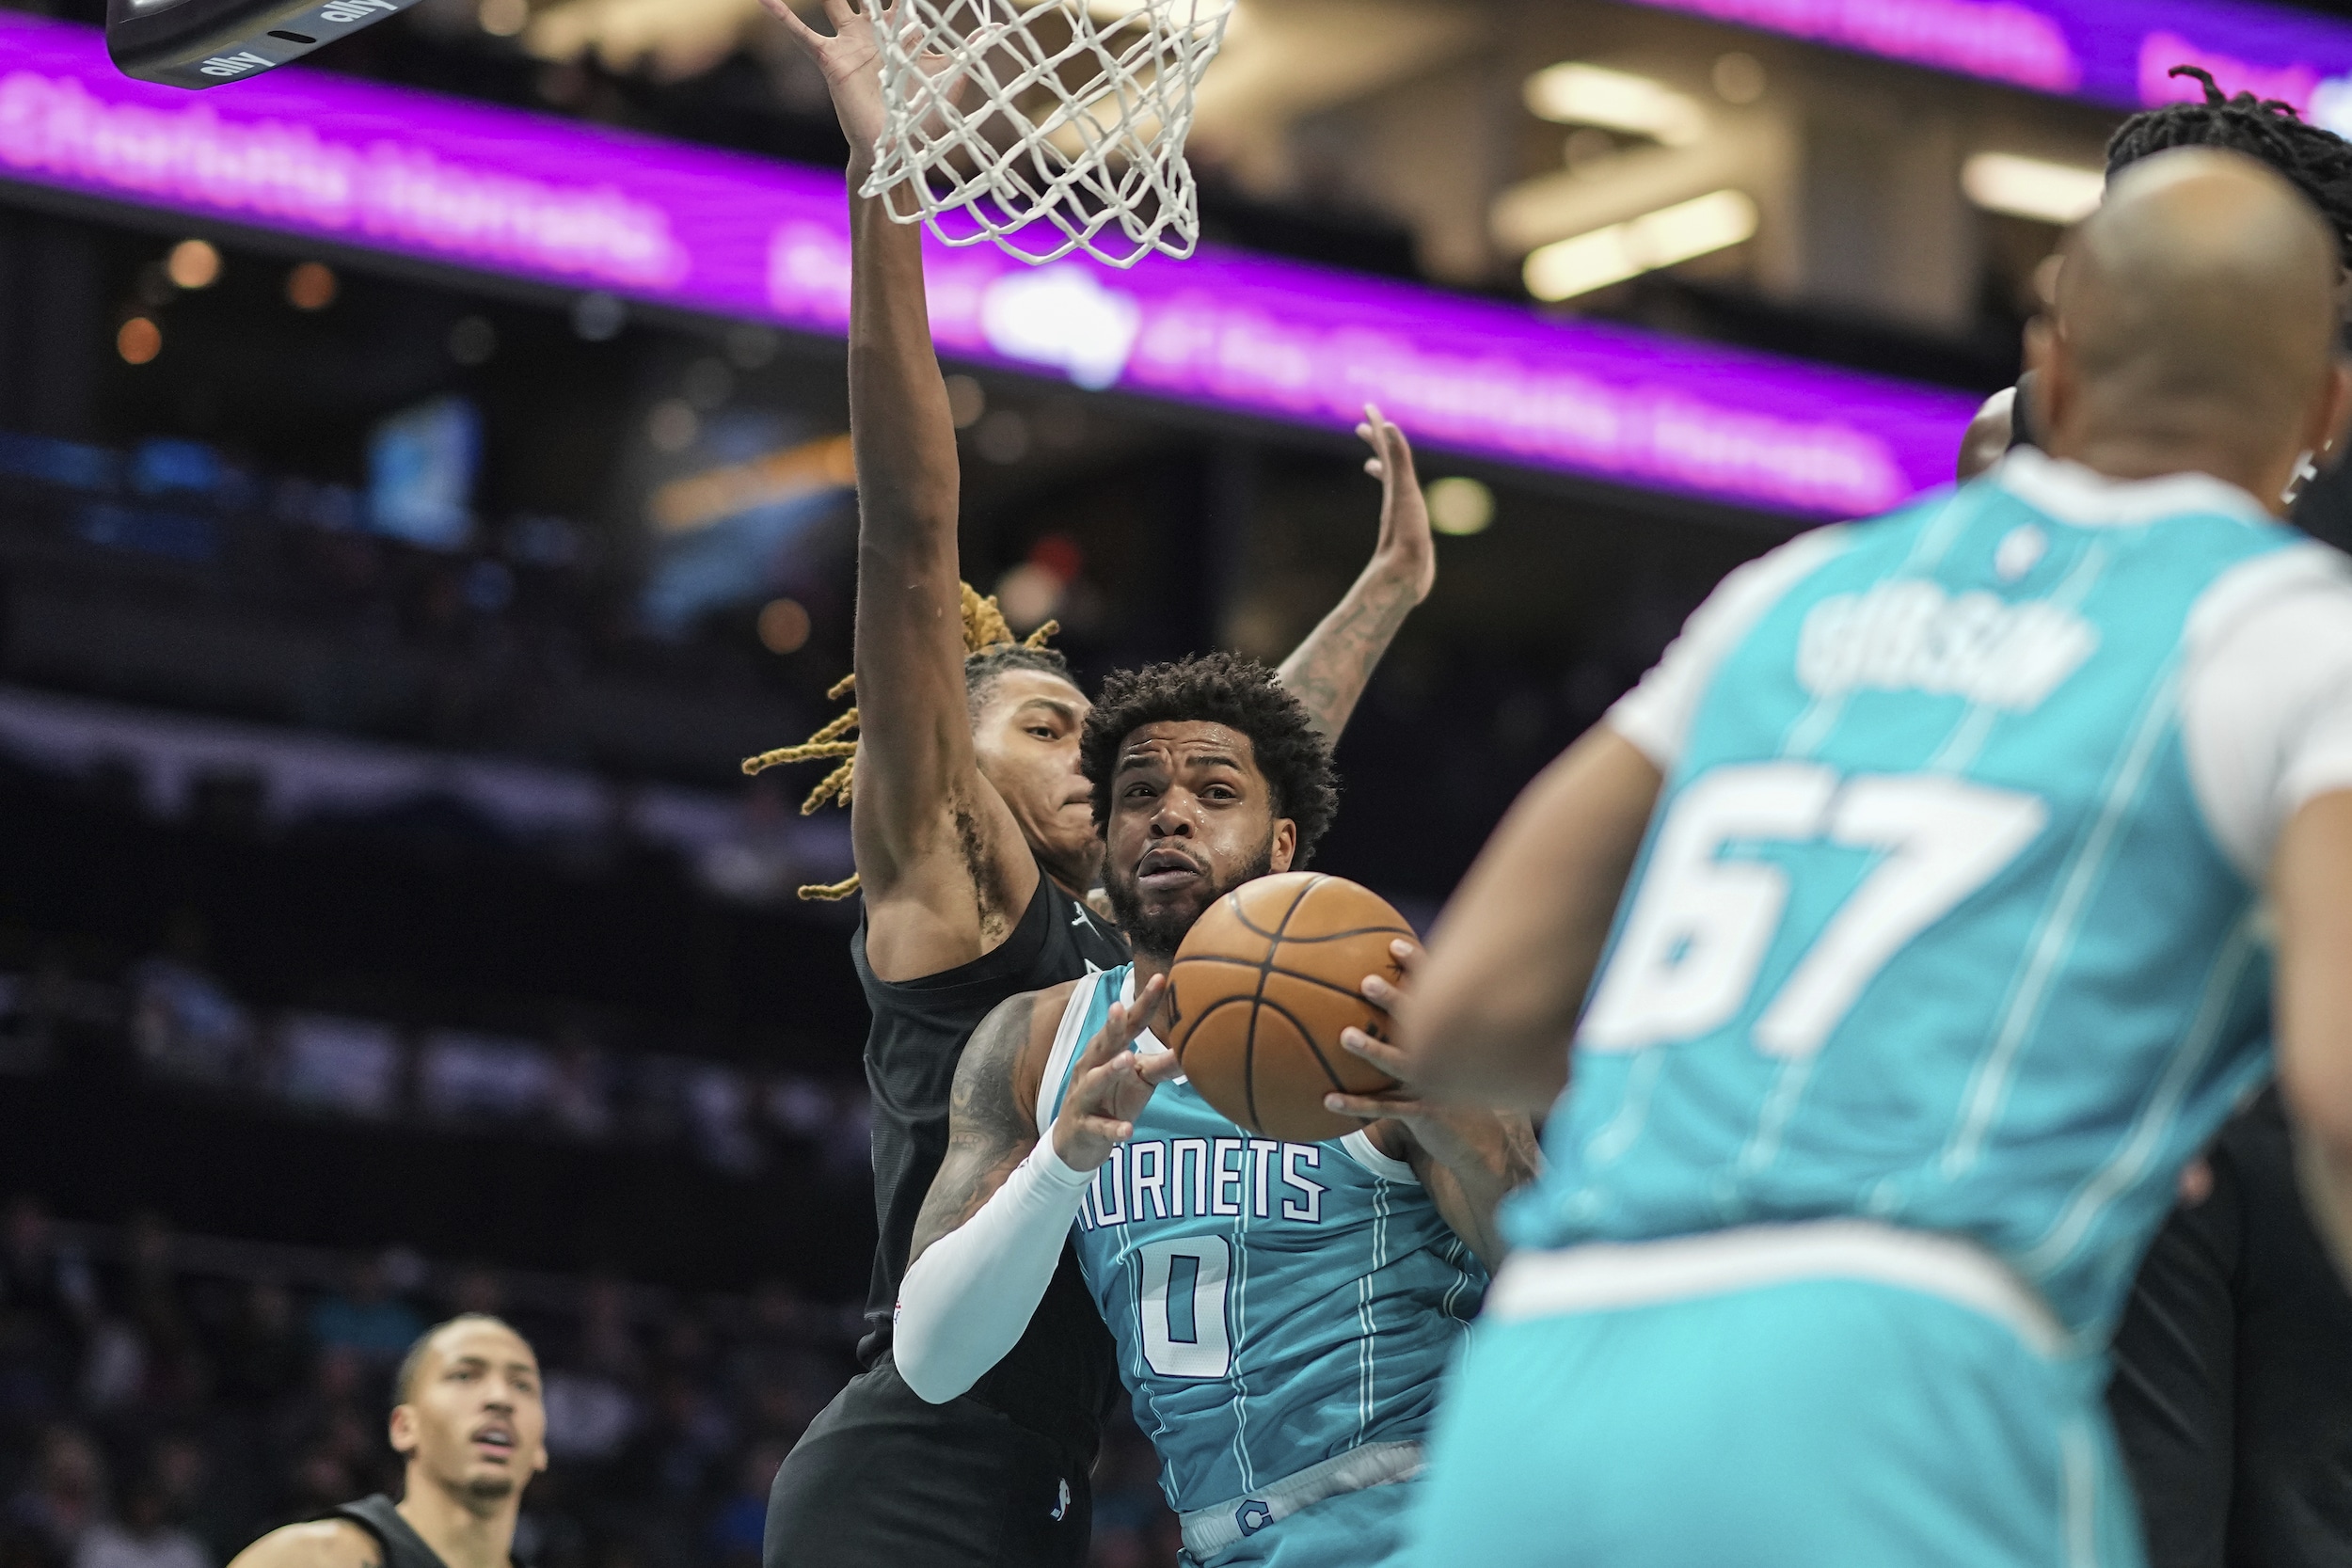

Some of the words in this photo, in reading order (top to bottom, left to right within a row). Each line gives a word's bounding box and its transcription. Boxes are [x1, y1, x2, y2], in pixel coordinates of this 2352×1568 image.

[320, 0, 399, 23] ally
[200, 52, 277, 77] ally
[1573, 758, 2051, 1059] 67
[1074, 1135, 1331, 1232] ORNETS
[1137, 1233, 1232, 1379] 0
